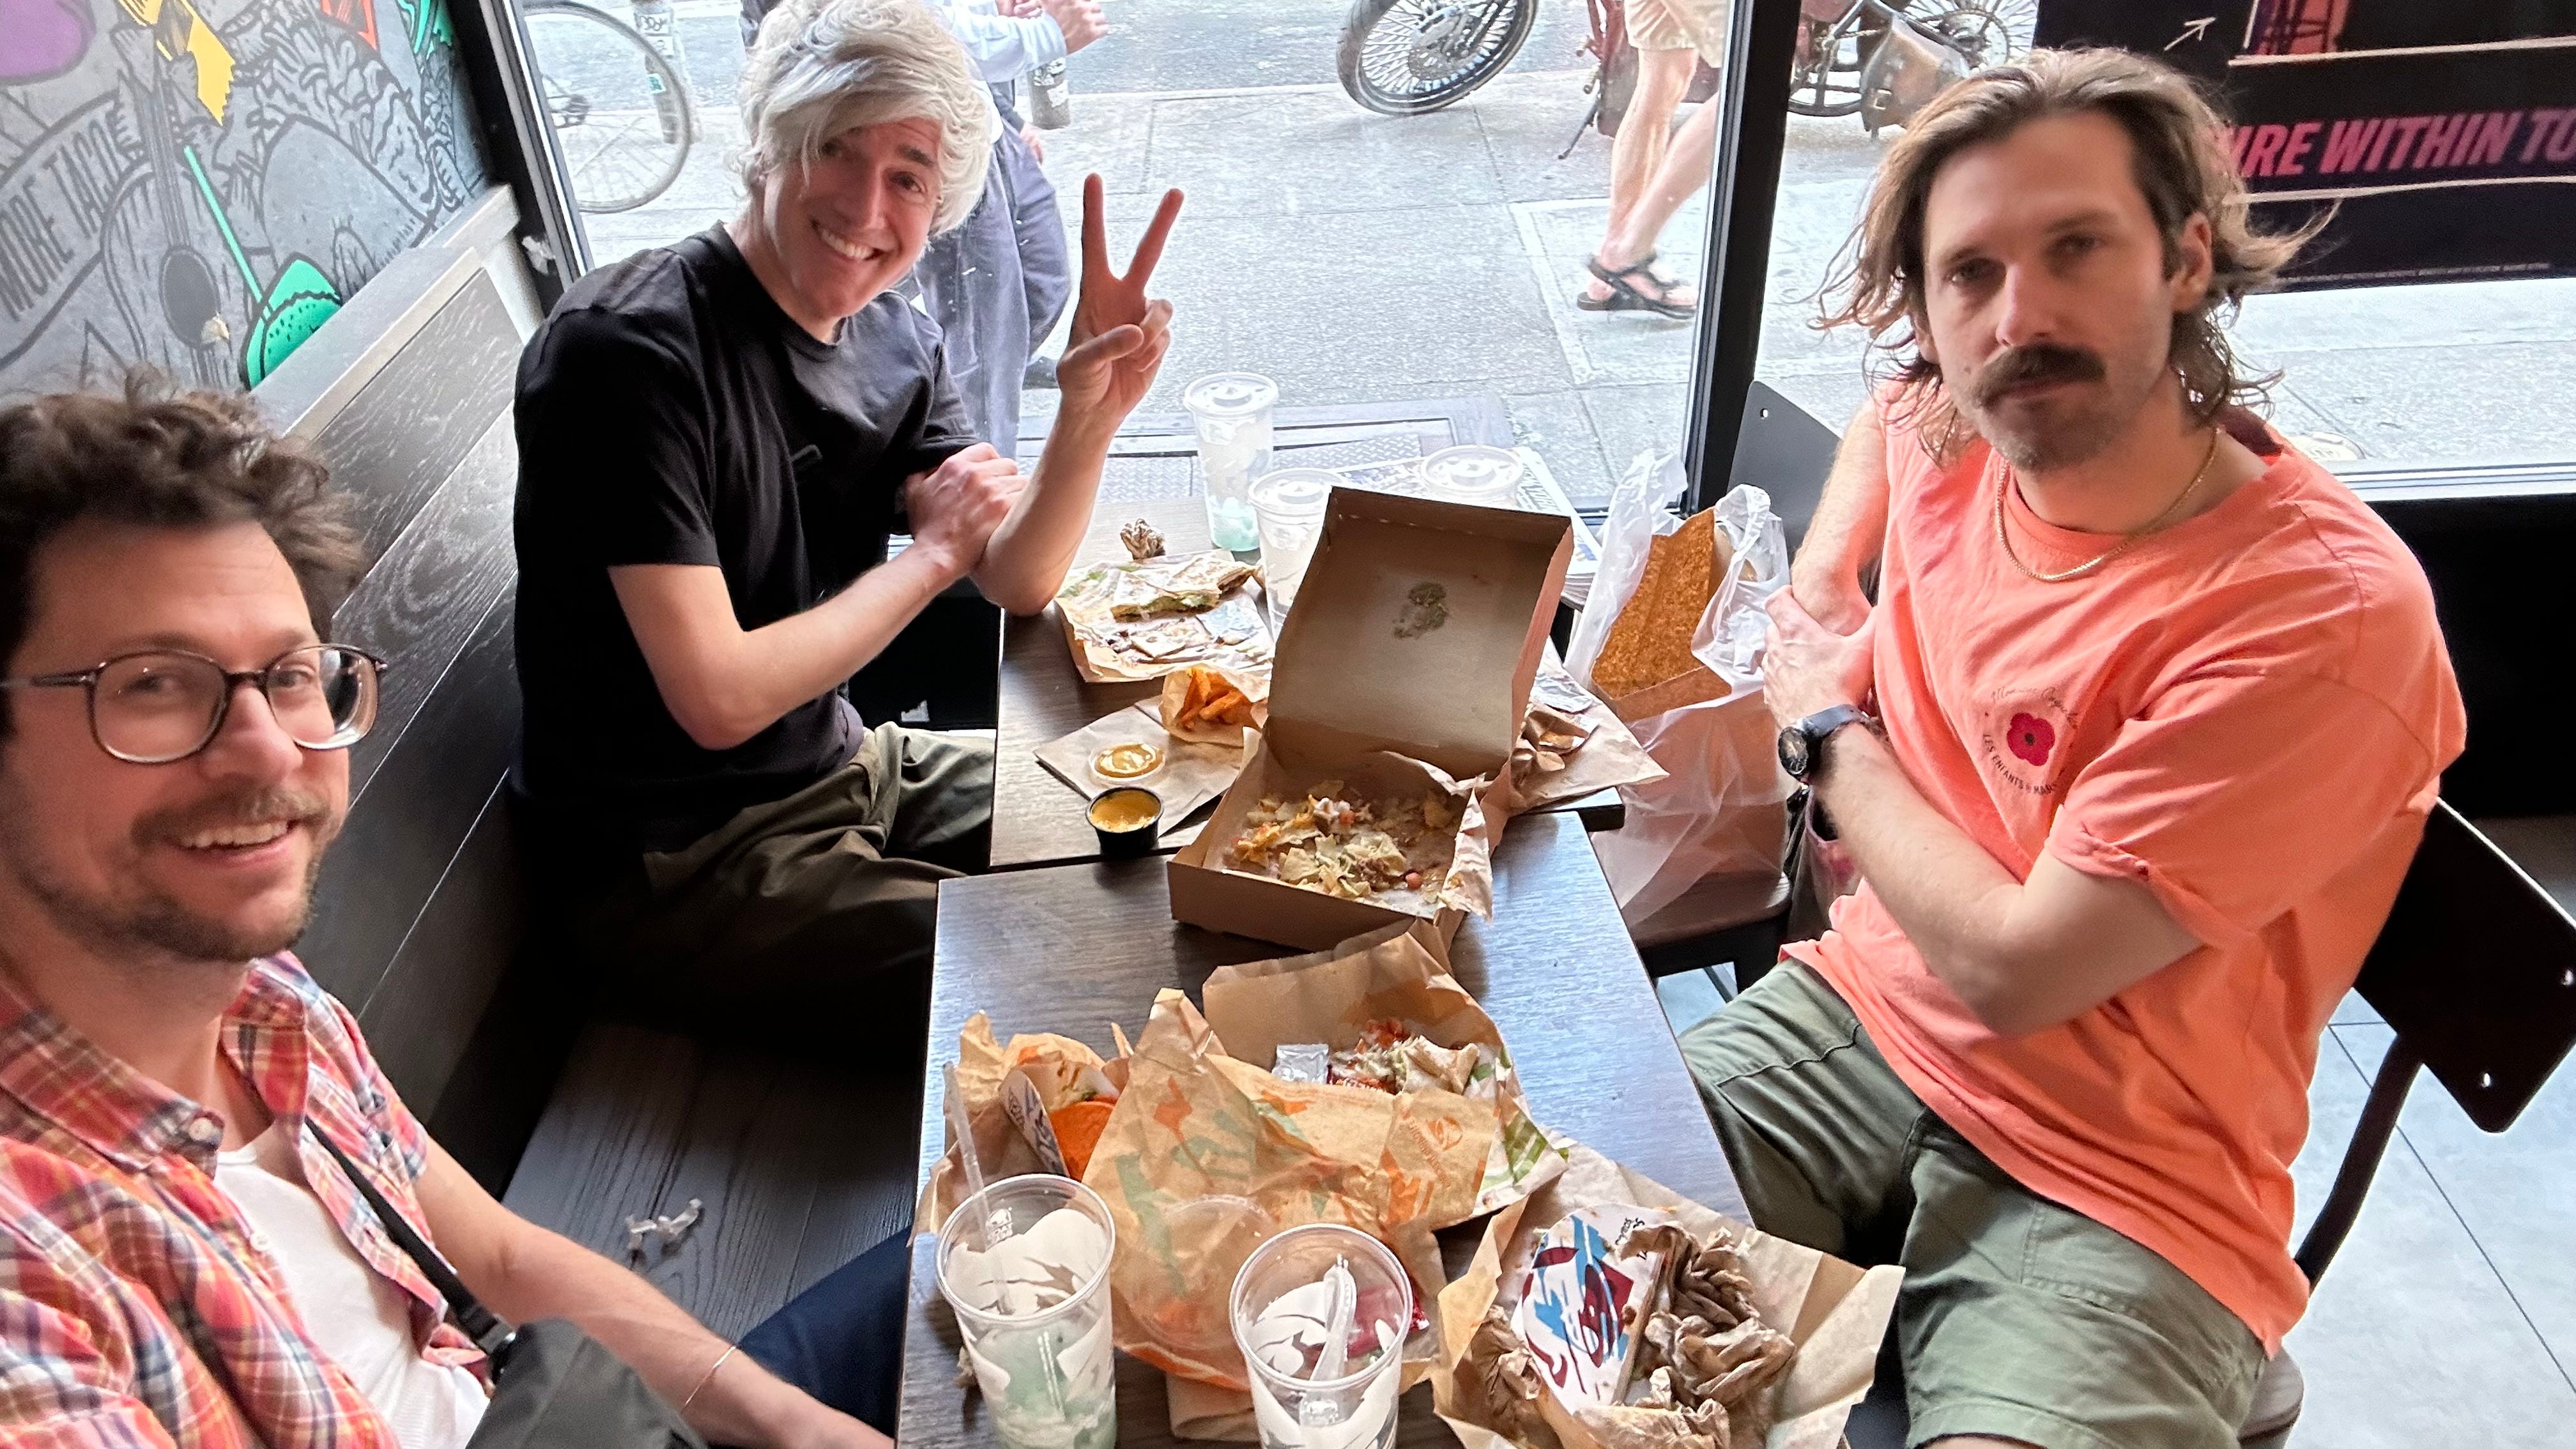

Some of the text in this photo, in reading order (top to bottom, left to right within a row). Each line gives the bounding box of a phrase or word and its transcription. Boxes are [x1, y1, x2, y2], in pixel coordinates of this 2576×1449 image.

[2319, 112, 2523, 173] WITHIN
[1982, 733, 2024, 790] LES ENFANTS
